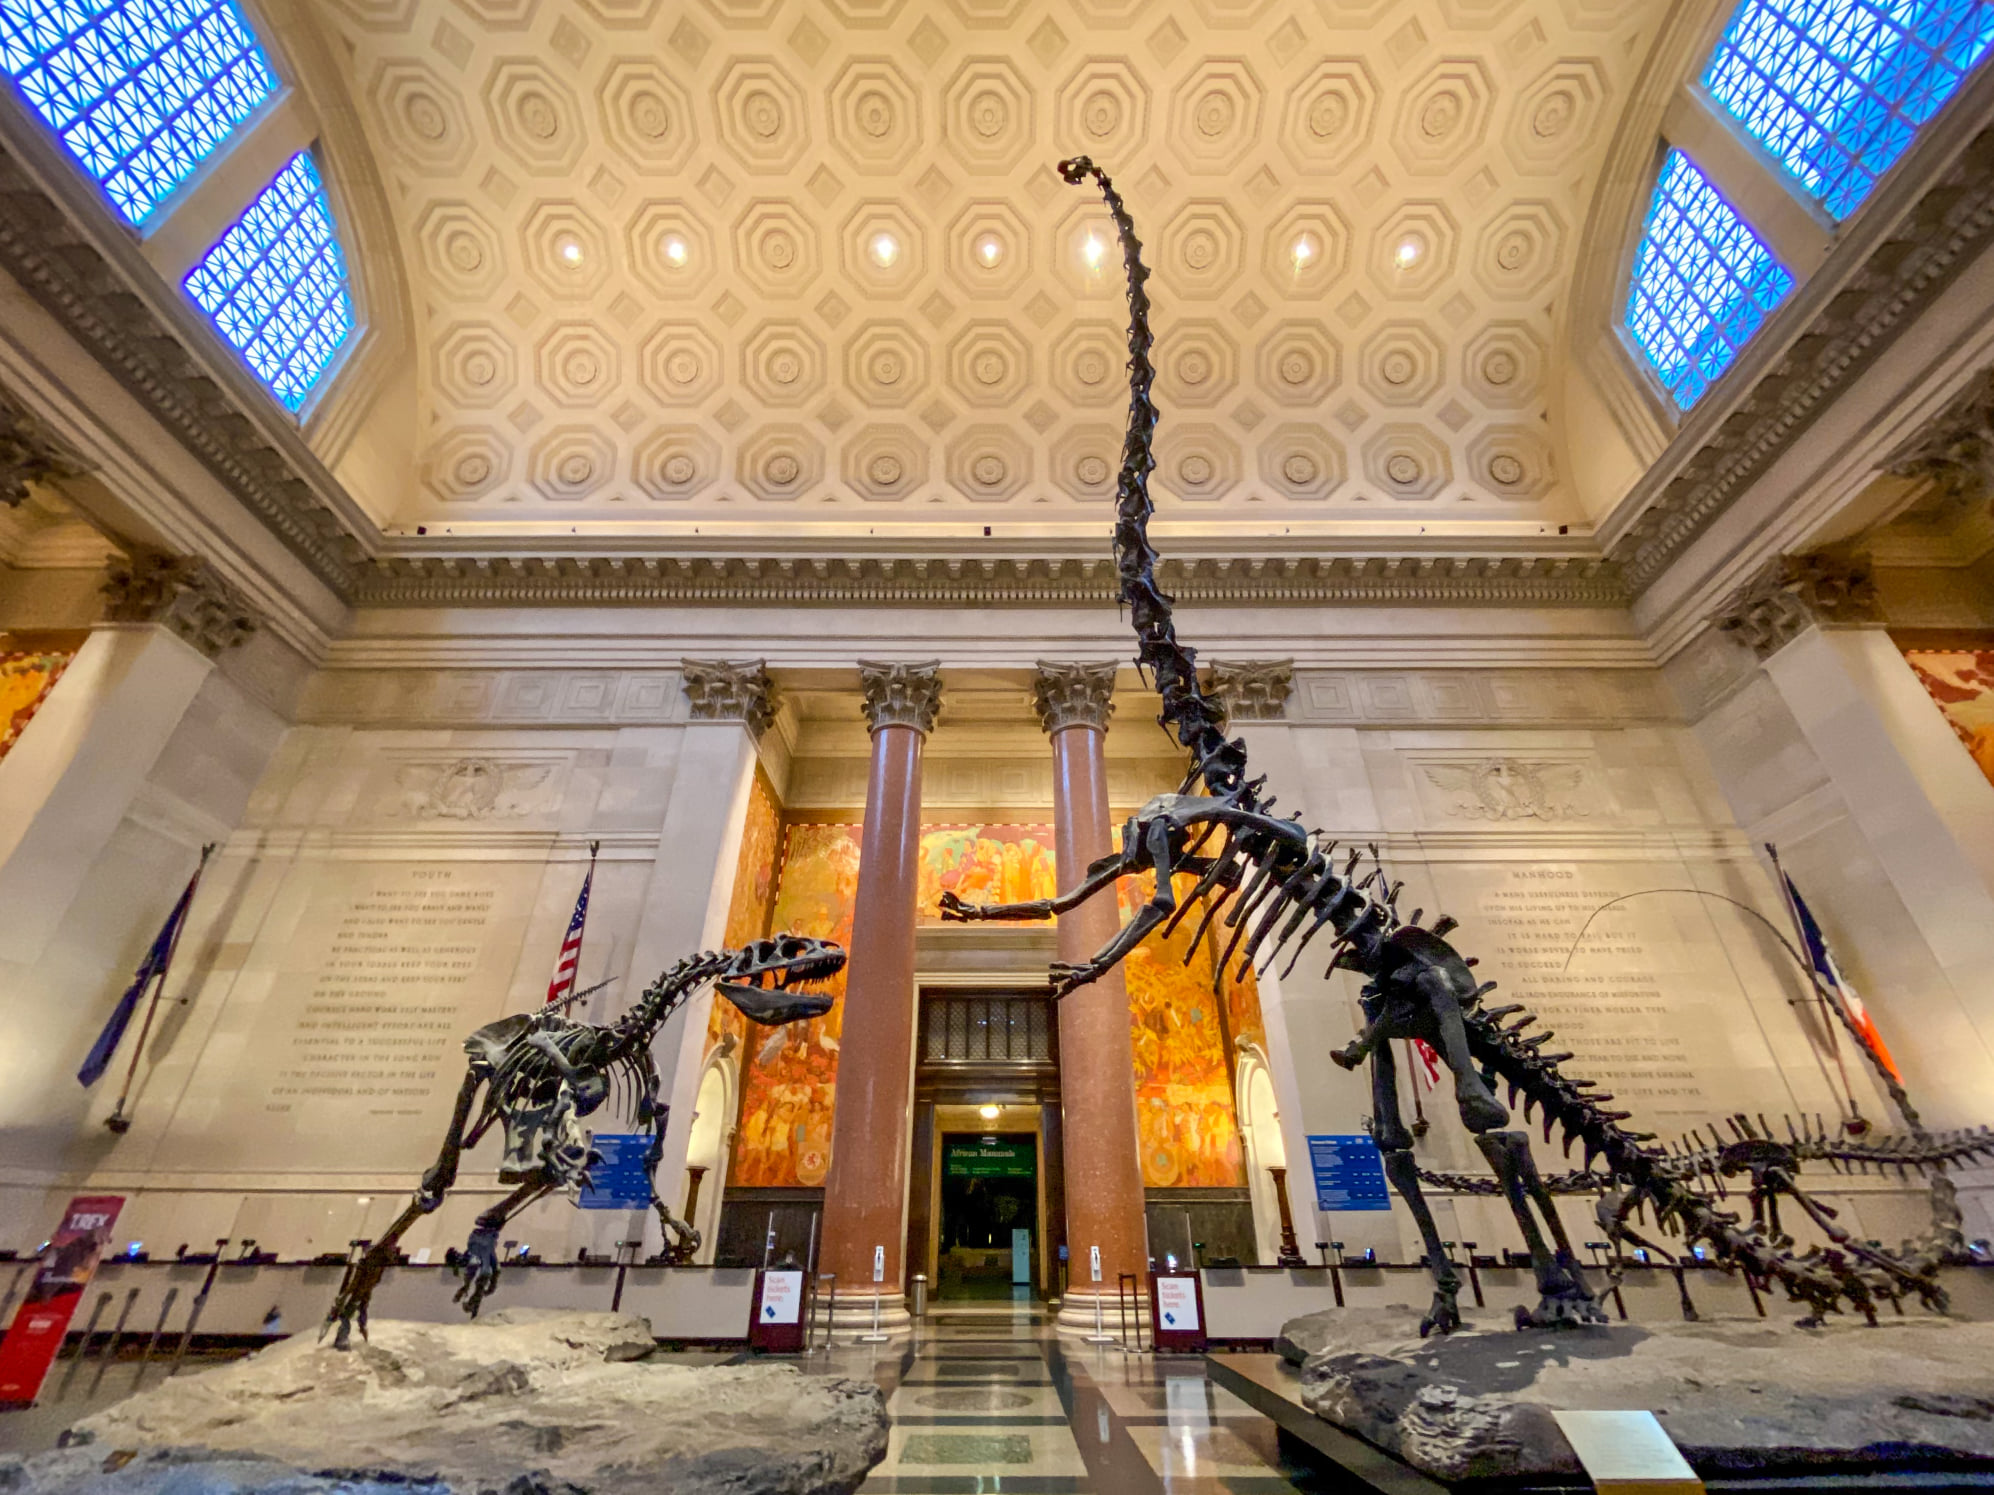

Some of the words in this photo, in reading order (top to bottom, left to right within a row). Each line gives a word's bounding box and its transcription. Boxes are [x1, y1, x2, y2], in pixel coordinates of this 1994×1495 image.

[412, 871, 452, 879] YOUTH
[1512, 871, 1574, 879] MANHOOD
[951, 1149, 978, 1157] African
[979, 1149, 1015, 1157] Mammals
